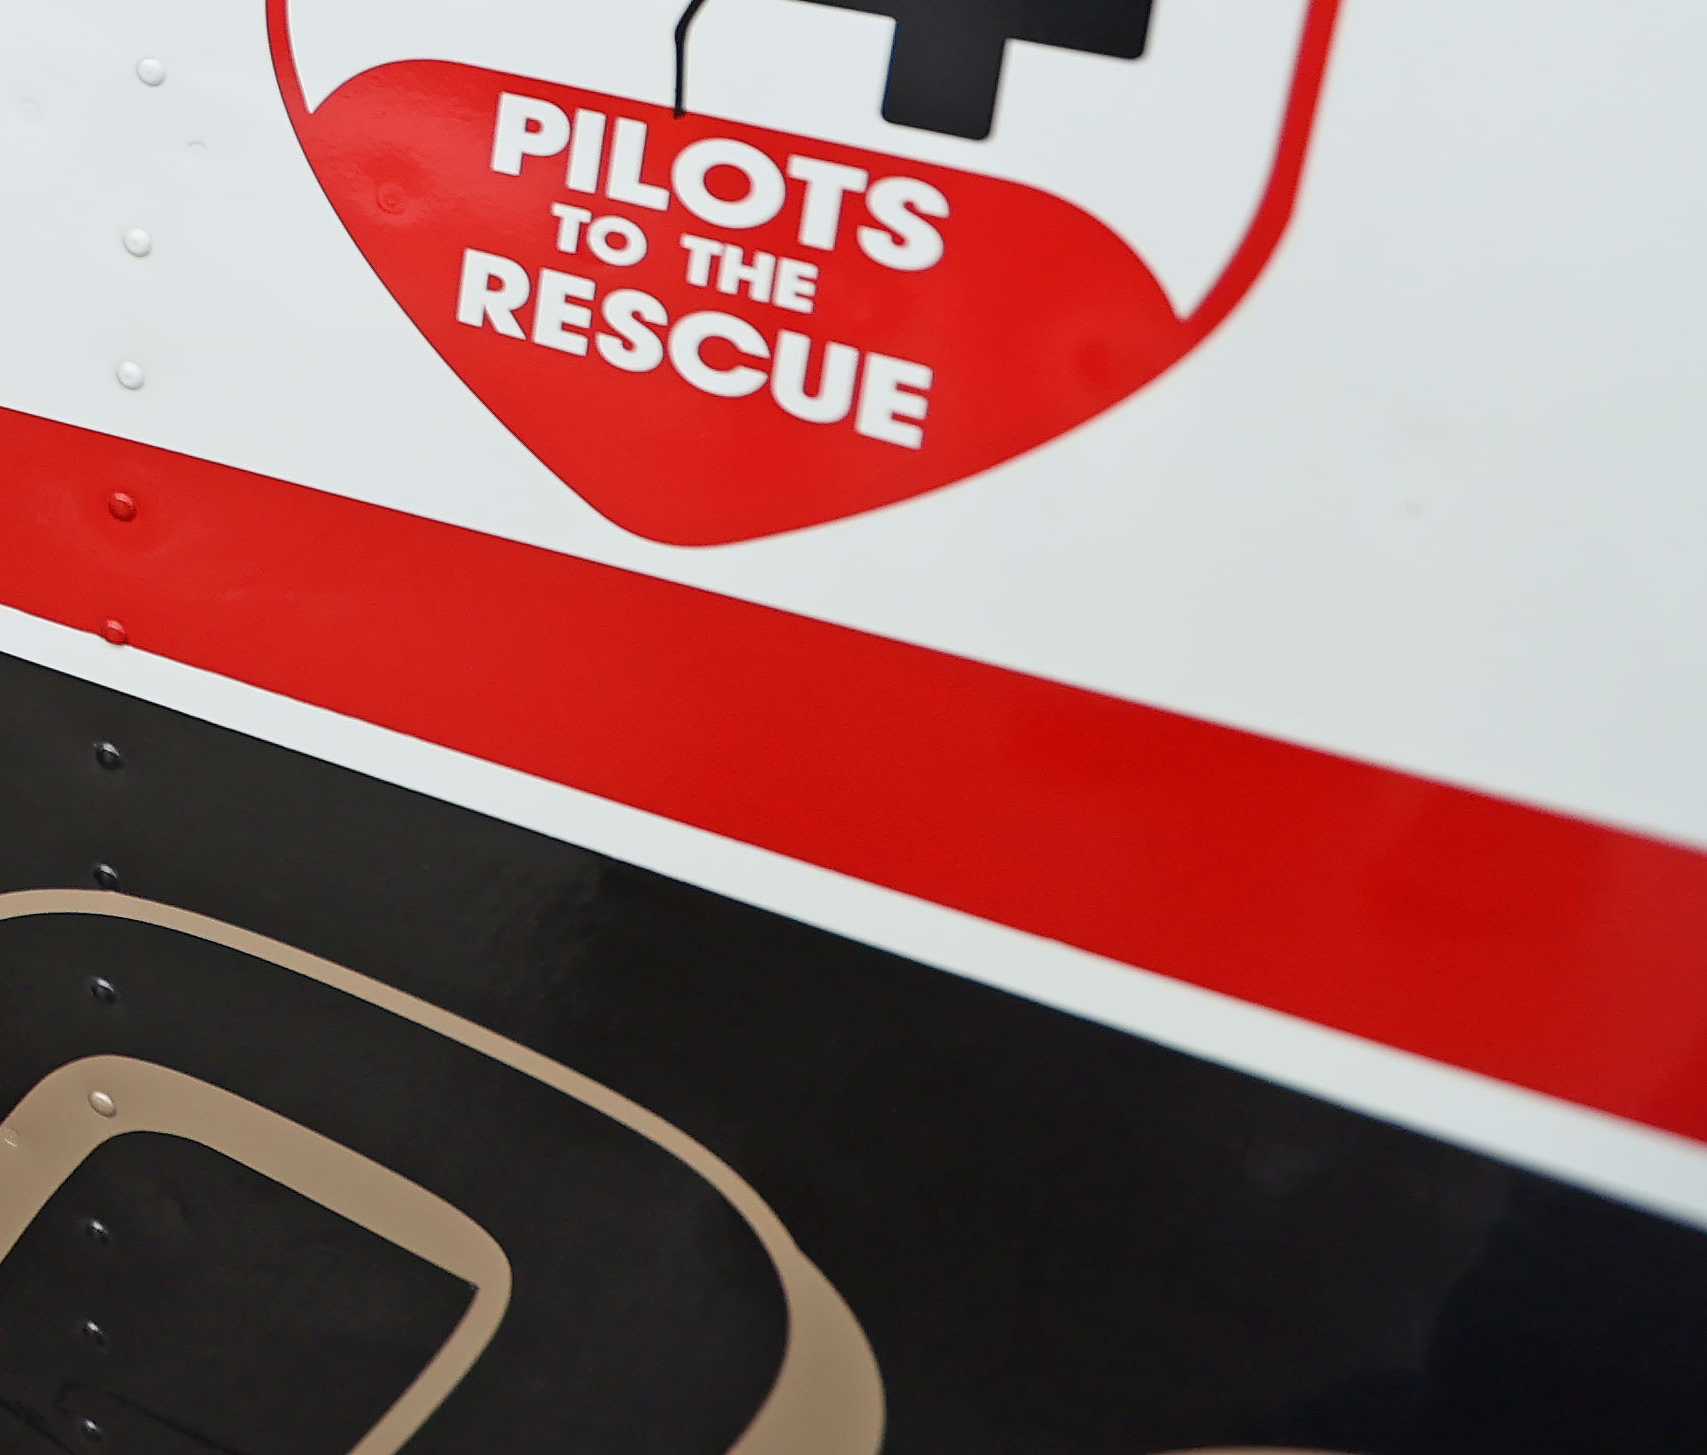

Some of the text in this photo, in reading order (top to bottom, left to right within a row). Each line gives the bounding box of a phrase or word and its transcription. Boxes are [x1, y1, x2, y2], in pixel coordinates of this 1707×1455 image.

[491, 91, 950, 271] PILOTS
[550, 202, 820, 315] TO THE
[456, 247, 934, 451] RESCUE
